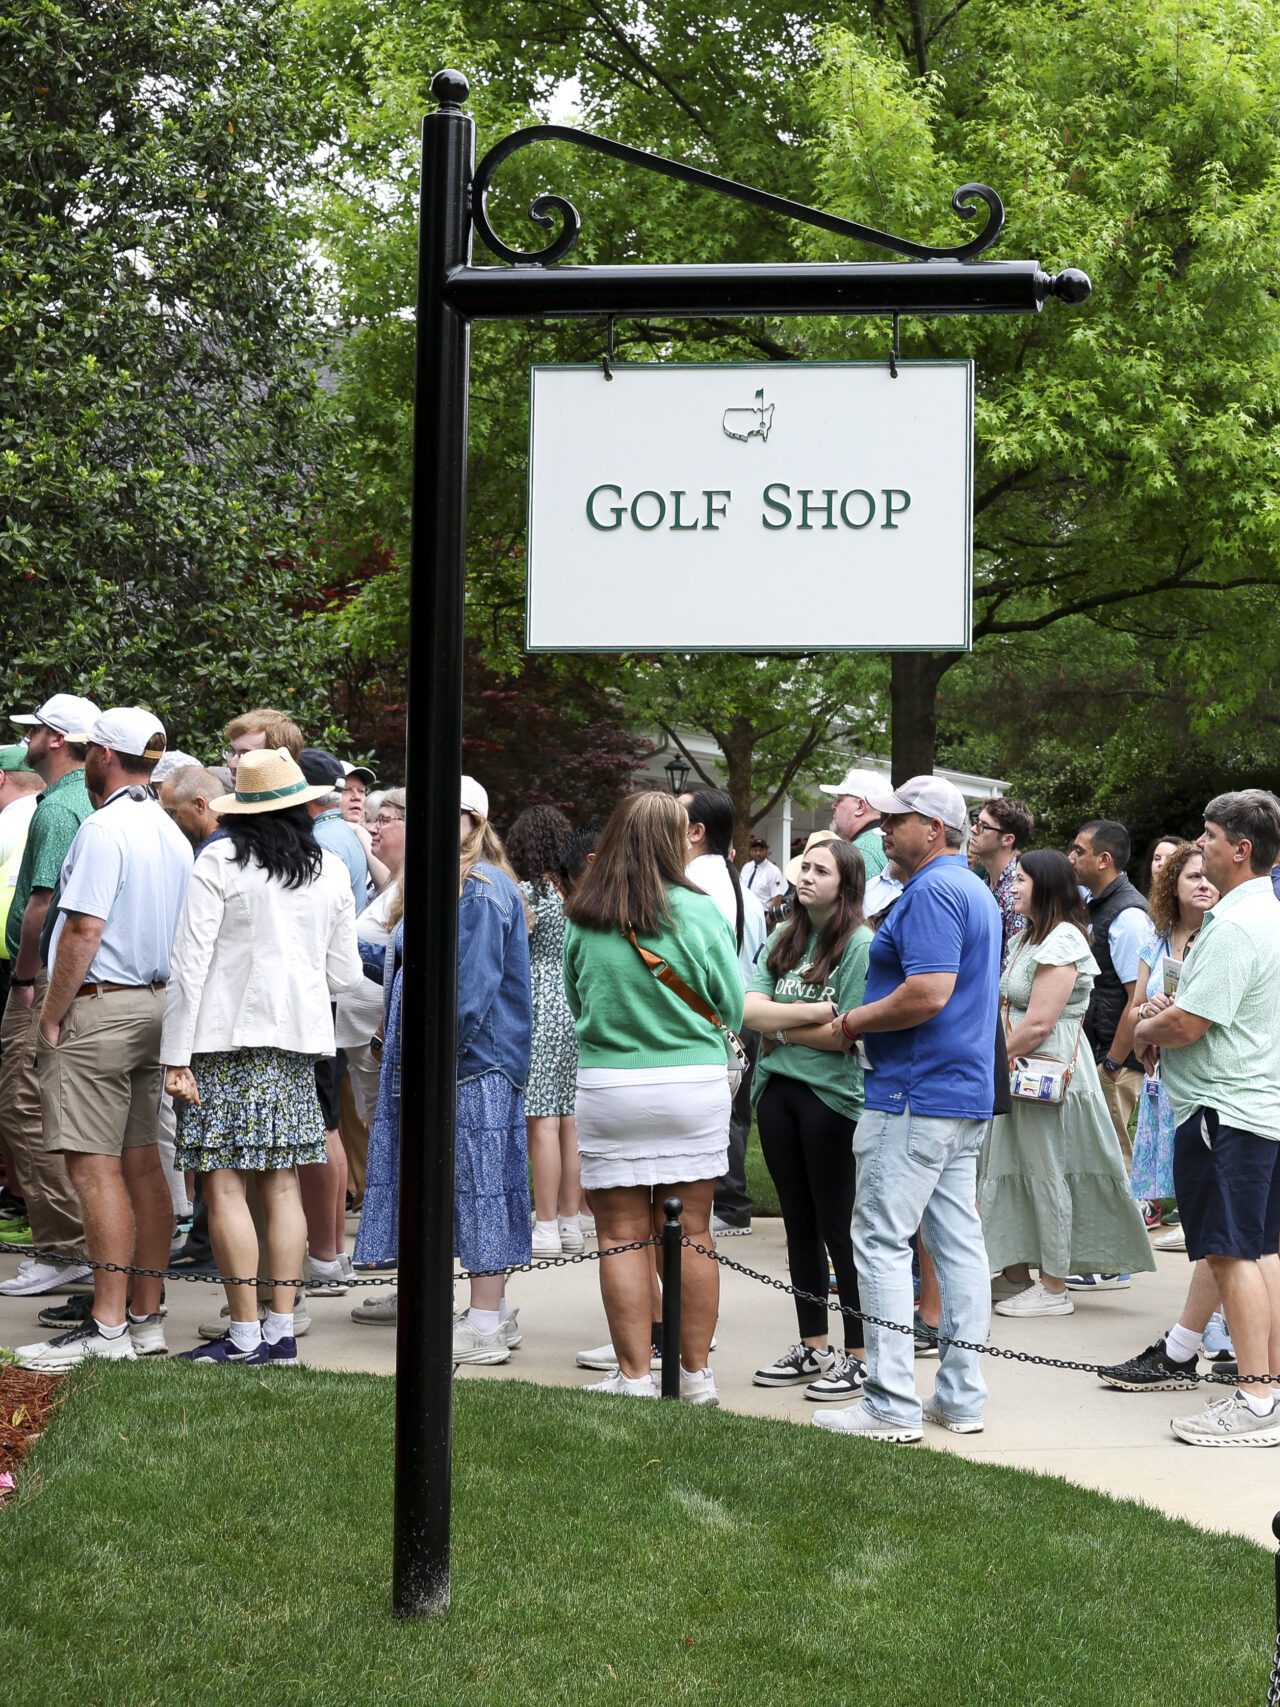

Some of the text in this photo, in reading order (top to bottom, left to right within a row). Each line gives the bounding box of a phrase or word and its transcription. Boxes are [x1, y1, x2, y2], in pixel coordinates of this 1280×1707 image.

[586, 482, 911, 531] GOLF SHOP
[775, 978, 836, 1002] ORNER
